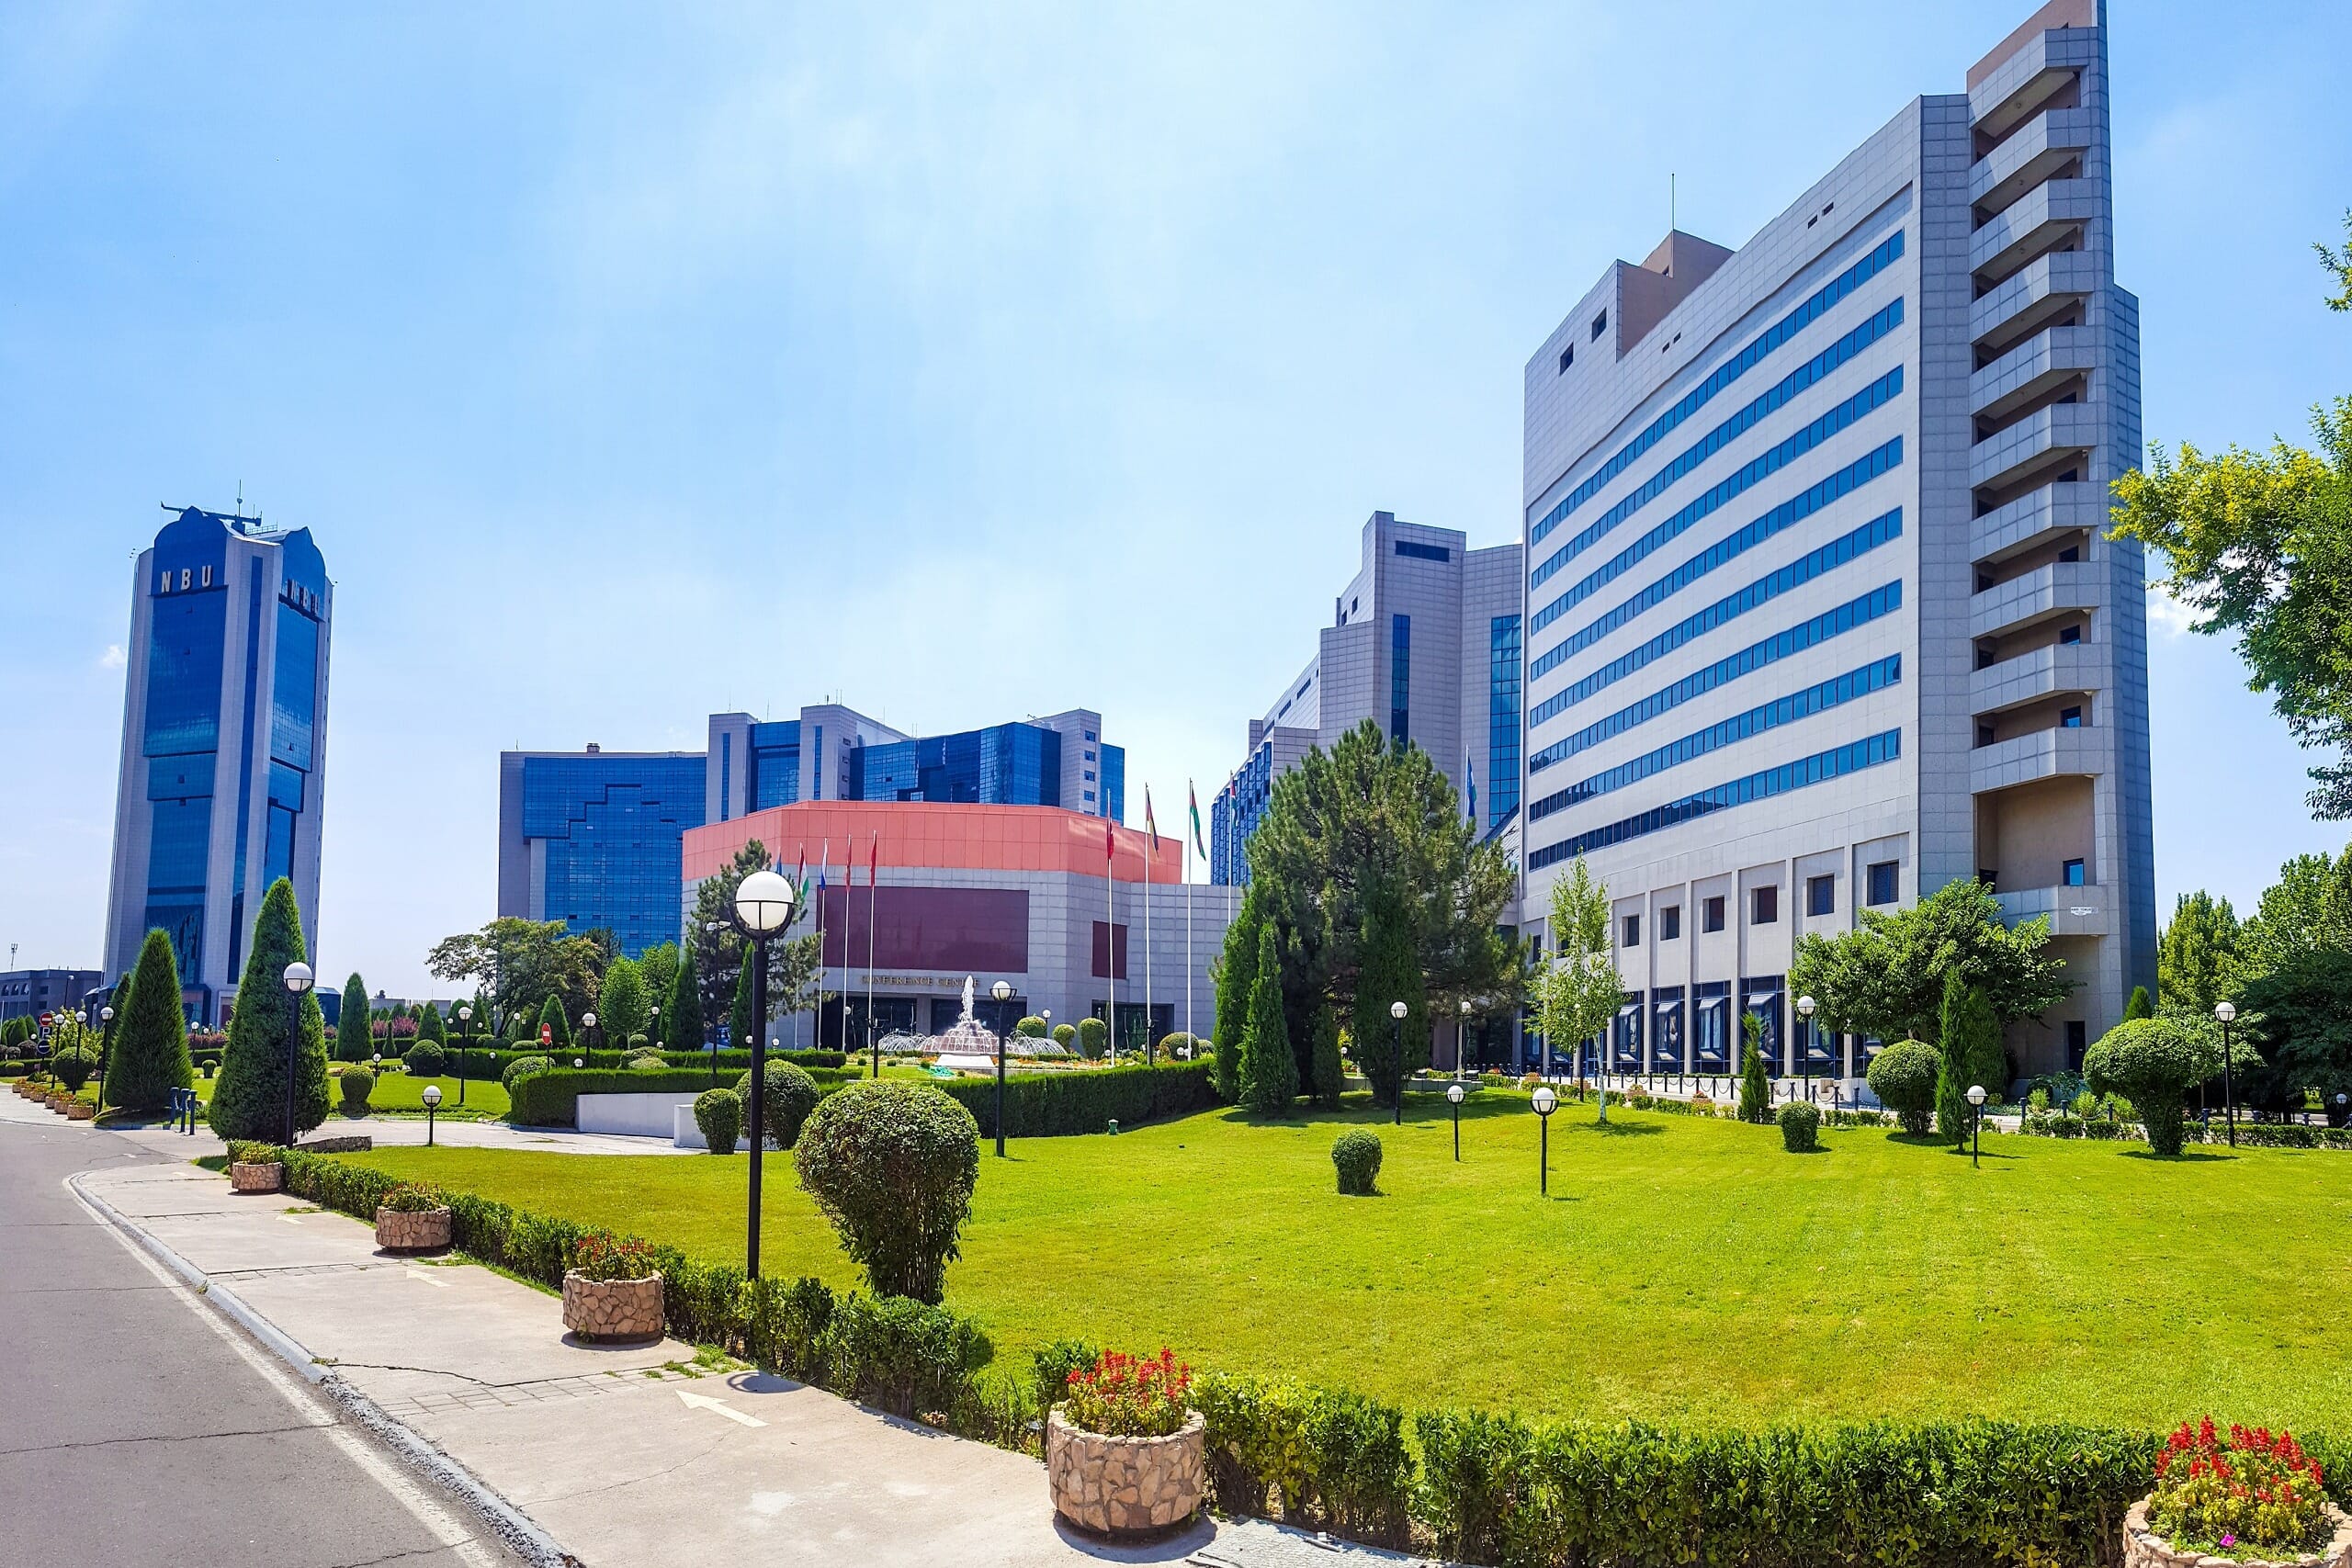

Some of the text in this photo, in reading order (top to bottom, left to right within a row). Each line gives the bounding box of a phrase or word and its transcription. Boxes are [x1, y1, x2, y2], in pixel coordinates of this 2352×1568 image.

[162, 565, 211, 592] NBU
[289, 579, 321, 616] NBU
[936, 976, 979, 987] CENTE
